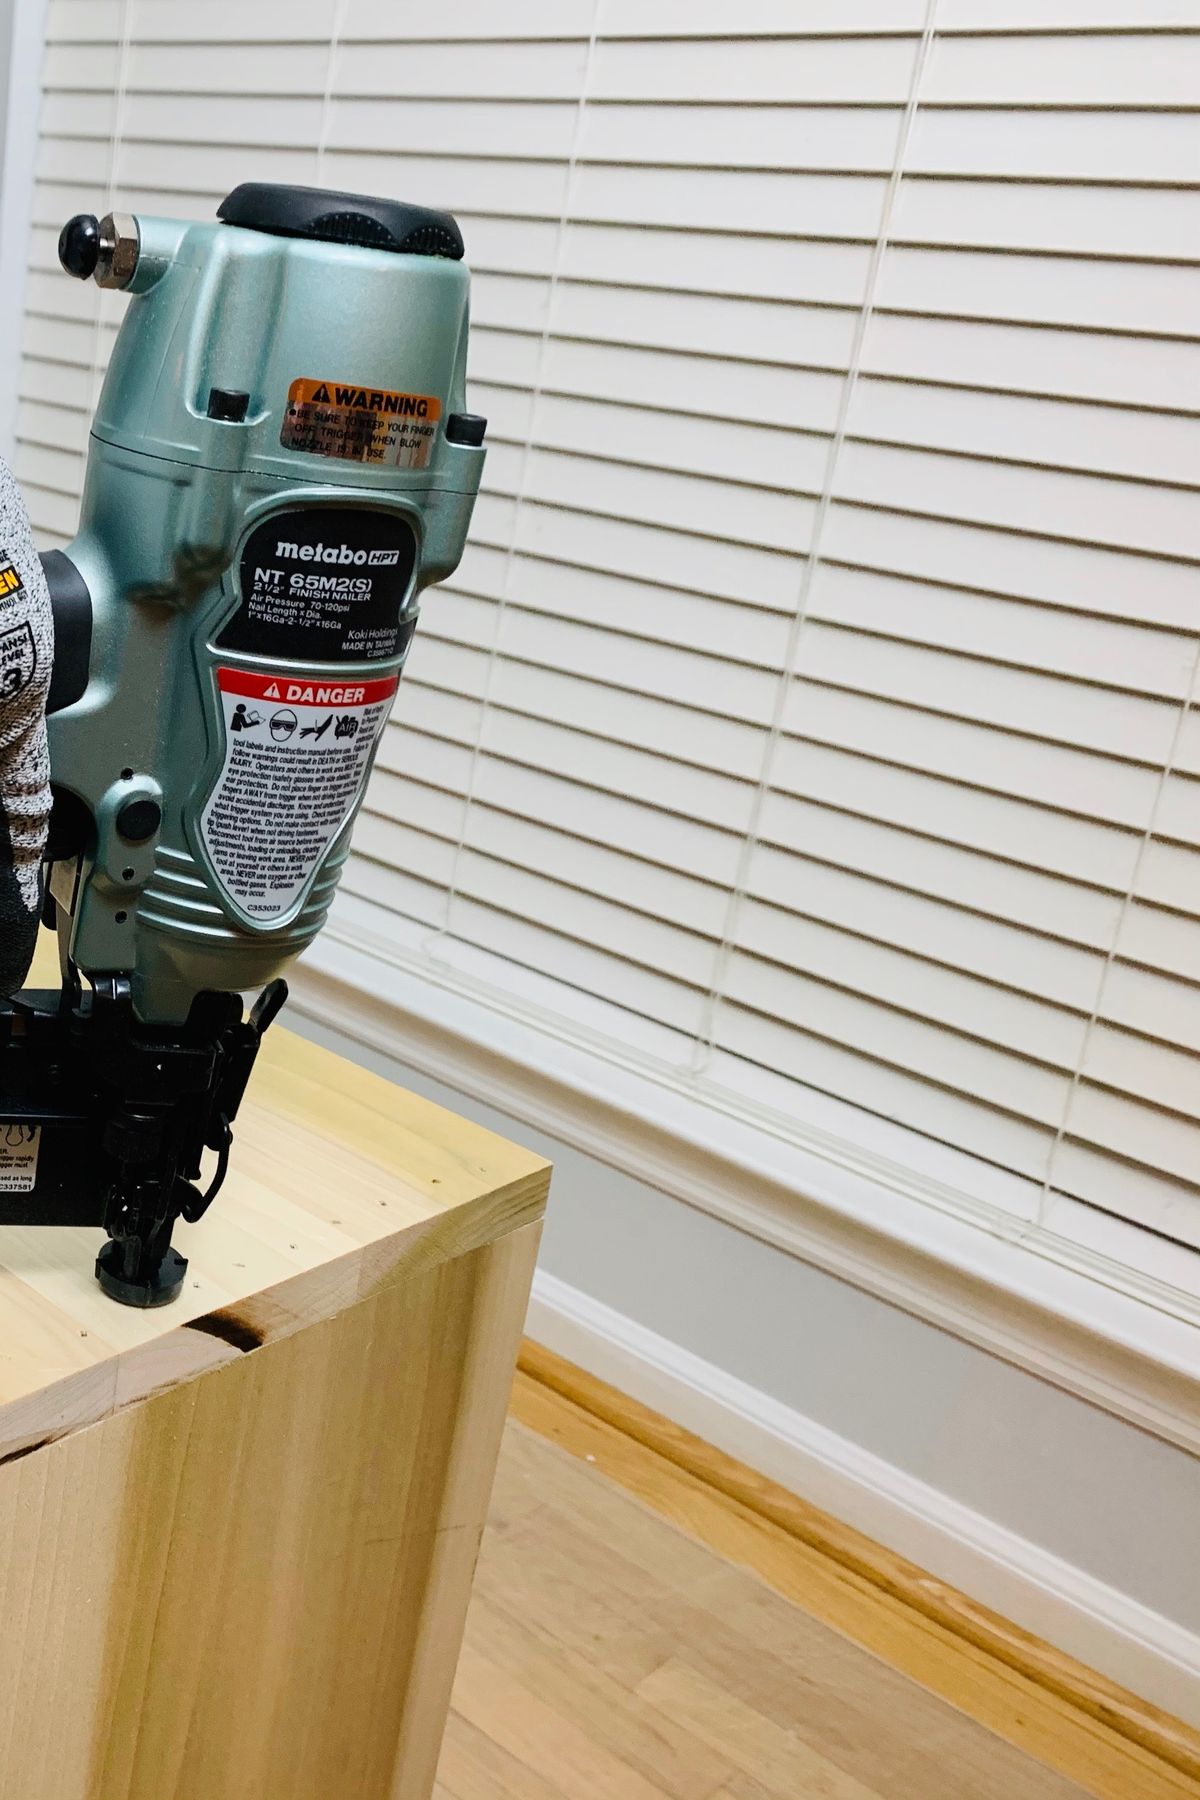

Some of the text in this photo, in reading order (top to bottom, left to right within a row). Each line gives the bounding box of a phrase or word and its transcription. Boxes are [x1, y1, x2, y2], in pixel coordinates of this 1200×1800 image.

[335, 387, 428, 417] WARNING
[314, 411, 340, 424] SURE
[345, 416, 356, 425] TO
[387, 421, 409, 433] YOUR
[294, 424, 422, 449] OFF TRIGGER WHEN BLOW
[291, 438, 332, 452] NOZZLE
[276, 541, 399, 566] metabo HPT
[254, 567, 372, 593] NT 65M2(S)
[289, 587, 330, 600] FINISH
[331, 592, 371, 601] NAILER
[251, 593, 350, 612] Air Pressure 70-120psi
[248, 602, 265, 611] Nail
[267, 605, 297, 616] Length
[306, 610, 322, 619] Dia.
[348, 629, 368, 639] Koki
[341, 641, 365, 650] MADE
[366, 641, 374, 649] IN
[286, 686, 365, 703] DANGER
[233, 738, 307, 756] tool labels and instruction
[232, 748, 295, 764] follow warnings could
[228, 767, 239, 776] eye
[240, 769, 271, 781] protection
[256, 762, 285, 773] Operators
[286, 765, 297, 774] and
[298, 765, 314, 774] others
[225, 776, 236, 784] ear
[236, 777, 268, 790] protection.
[271, 782, 280, 791] Do
[222, 784, 243, 796] fingers
[243, 788, 263, 797] AWAY
[264, 790, 277, 799] from
[218, 794, 235, 803] avoid
[236, 796, 266, 808] accidental
[298, 801, 312, 810] Know
[214, 802, 229, 810] what
[230, 804, 249, 815] trigger
[250, 807, 272, 818] system
[273, 811, 284, 819] you
[210, 809, 239, 821] triggering
[265, 819, 273, 827] Do
[274, 819, 284, 827] not
[284, 820, 300, 828] make
[207, 827, 241, 840] Disconnect
[242, 833, 254, 842] tool
[255, 836, 268, 844] from
[277, 838, 295, 846] source
[250, 827, 266, 835] when
[266, 828, 276, 836] not
[277, 828, 295, 837] driving
[213, 848, 228, 857] jams
[236, 851, 257, 862] leaving
[258, 854, 272, 862] work
[247, 845, 268, 855] loading
[216, 857, 228, 866] tool
[228, 859, 235, 867] at
[236, 862, 259, 871] yourself
[235, 870, 256, 878] NEVER
[267, 873, 288, 881] oxygen
[227, 878, 249, 887] bottled
[269, 881, 294, 890] Explosion
[235, 889, 248, 897] may
[247, 904, 281, 912] C353023
